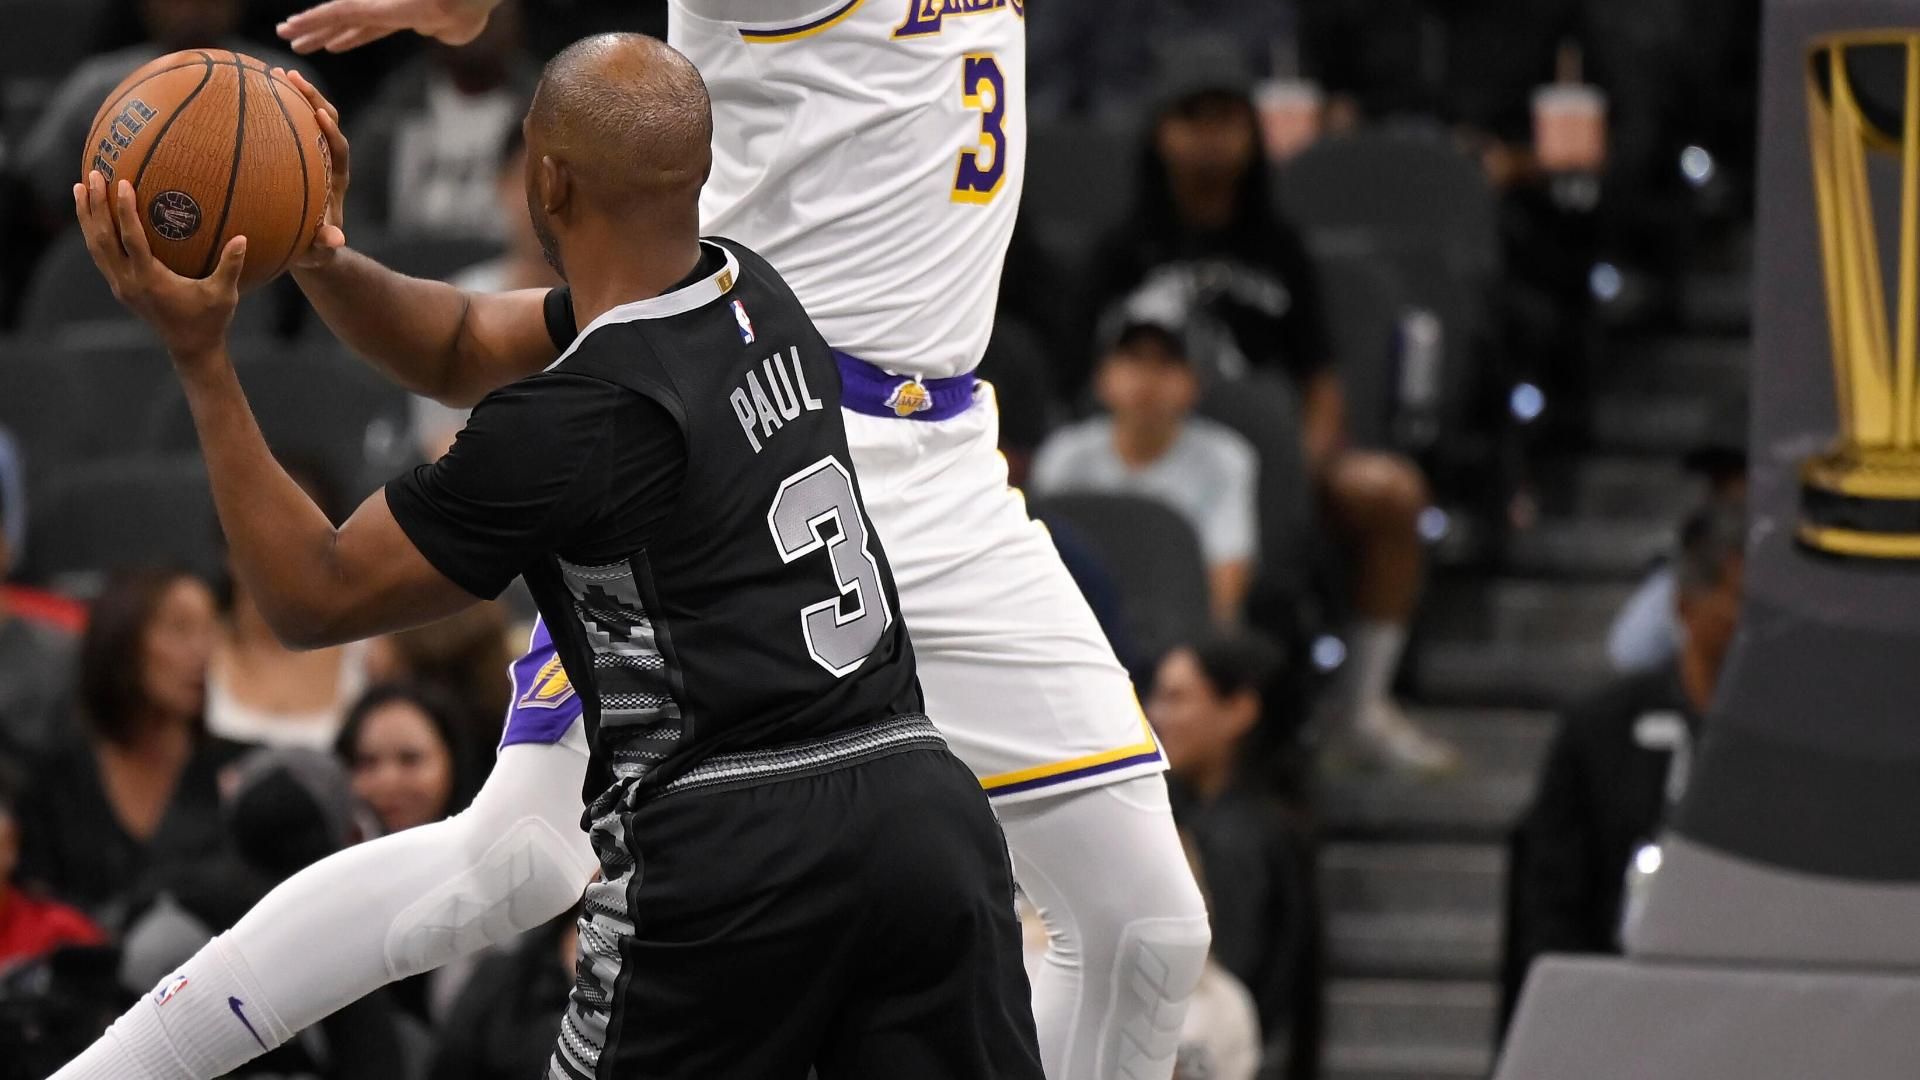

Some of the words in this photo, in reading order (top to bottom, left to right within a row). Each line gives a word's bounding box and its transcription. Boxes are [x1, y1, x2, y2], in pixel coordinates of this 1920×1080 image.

[950, 52, 1007, 206] 3
[730, 346, 823, 453] PAUL
[767, 454, 893, 678] 3
